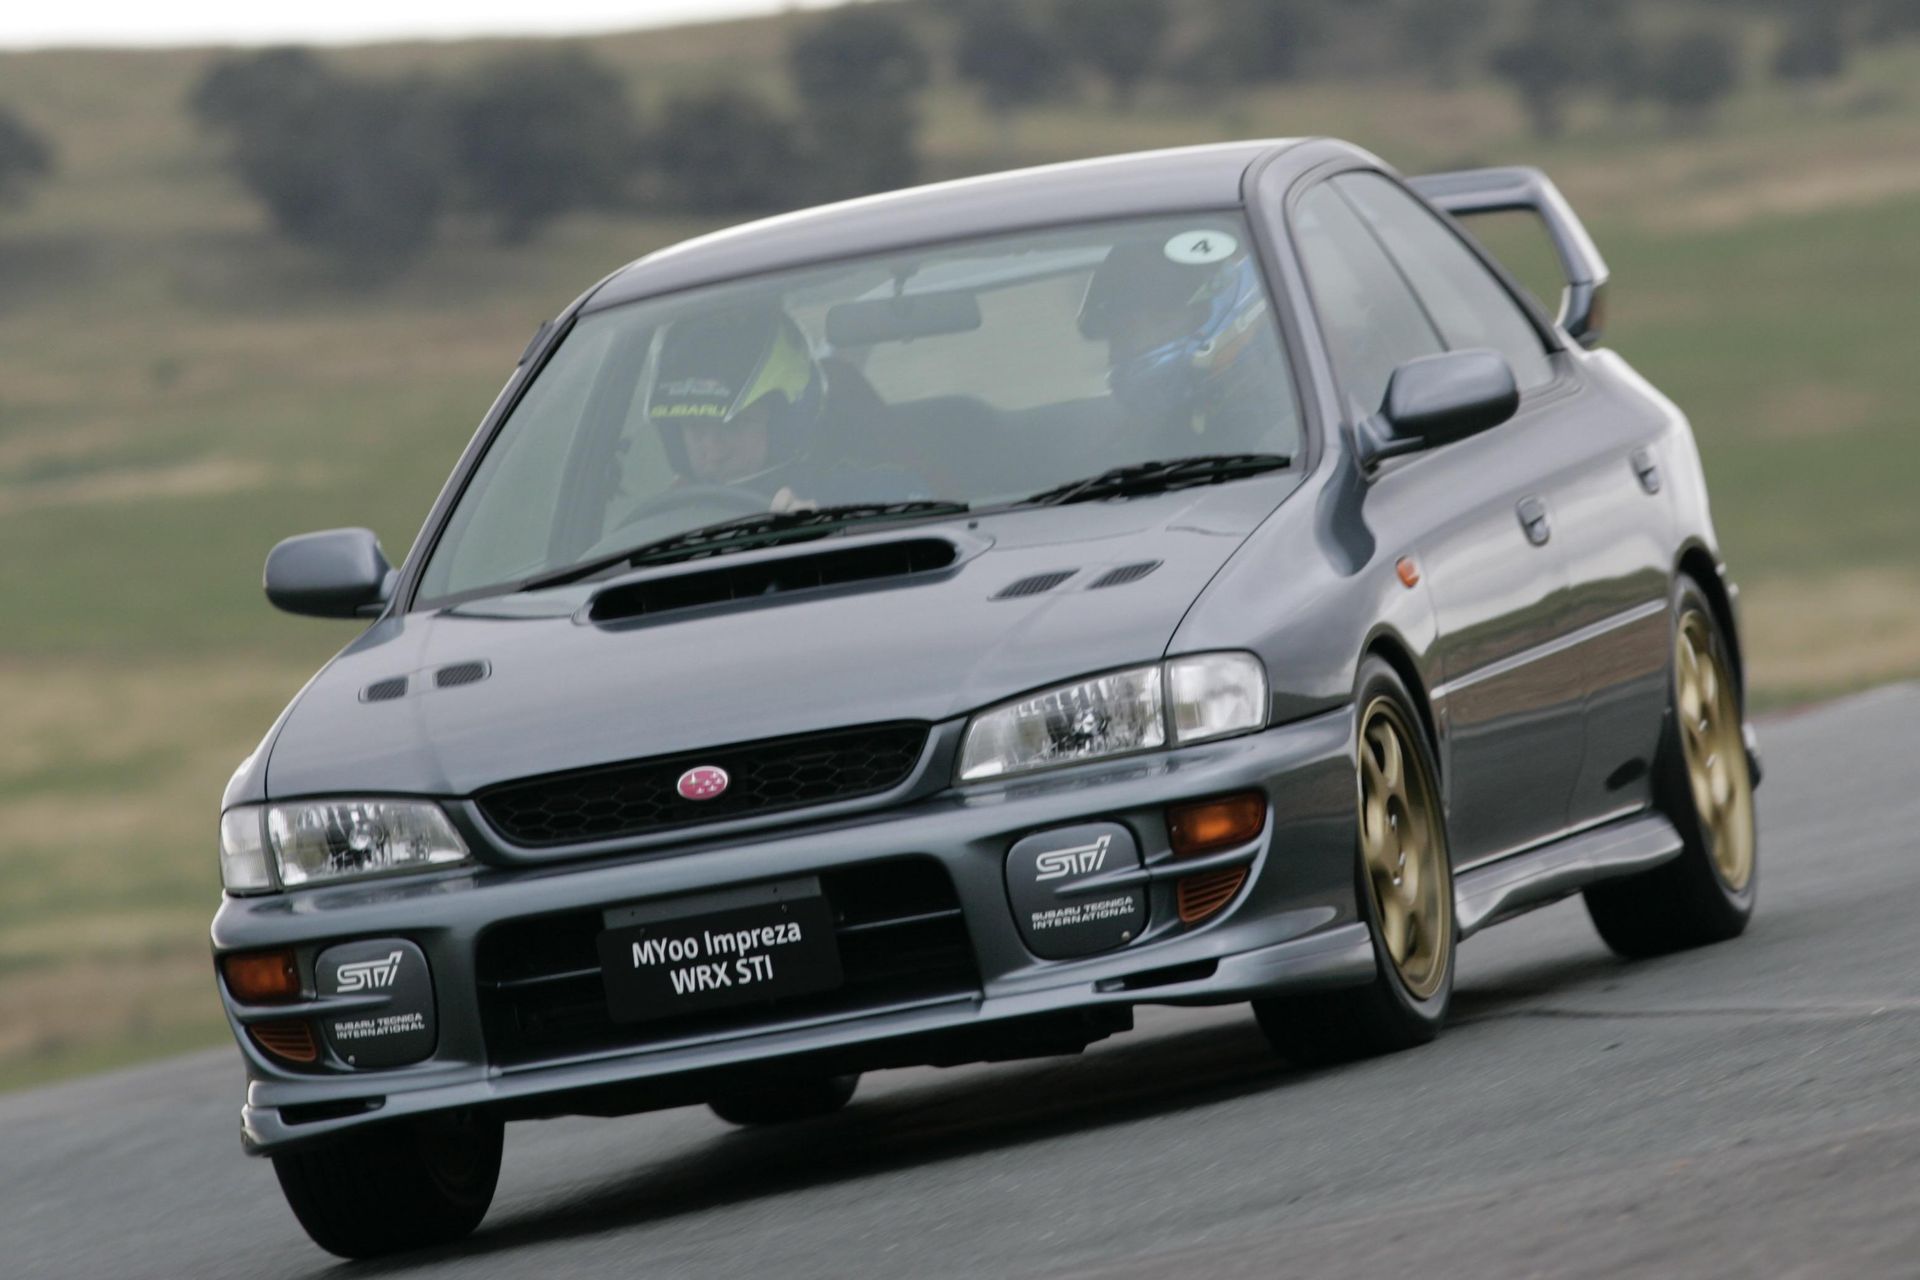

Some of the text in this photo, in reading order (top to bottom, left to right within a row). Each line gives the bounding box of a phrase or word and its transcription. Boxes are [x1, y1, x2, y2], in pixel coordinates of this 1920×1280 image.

[1032, 896, 1134, 922] SUBARU TECNICA
[1033, 905, 1135, 931] INTERNATIONAL
[704, 921, 801, 956] Impreza
[670, 954, 774, 995] WRX STI
[335, 1012, 423, 1032] SUBARU TECNICA
[336, 1021, 425, 1040] INTERNATIONAL
